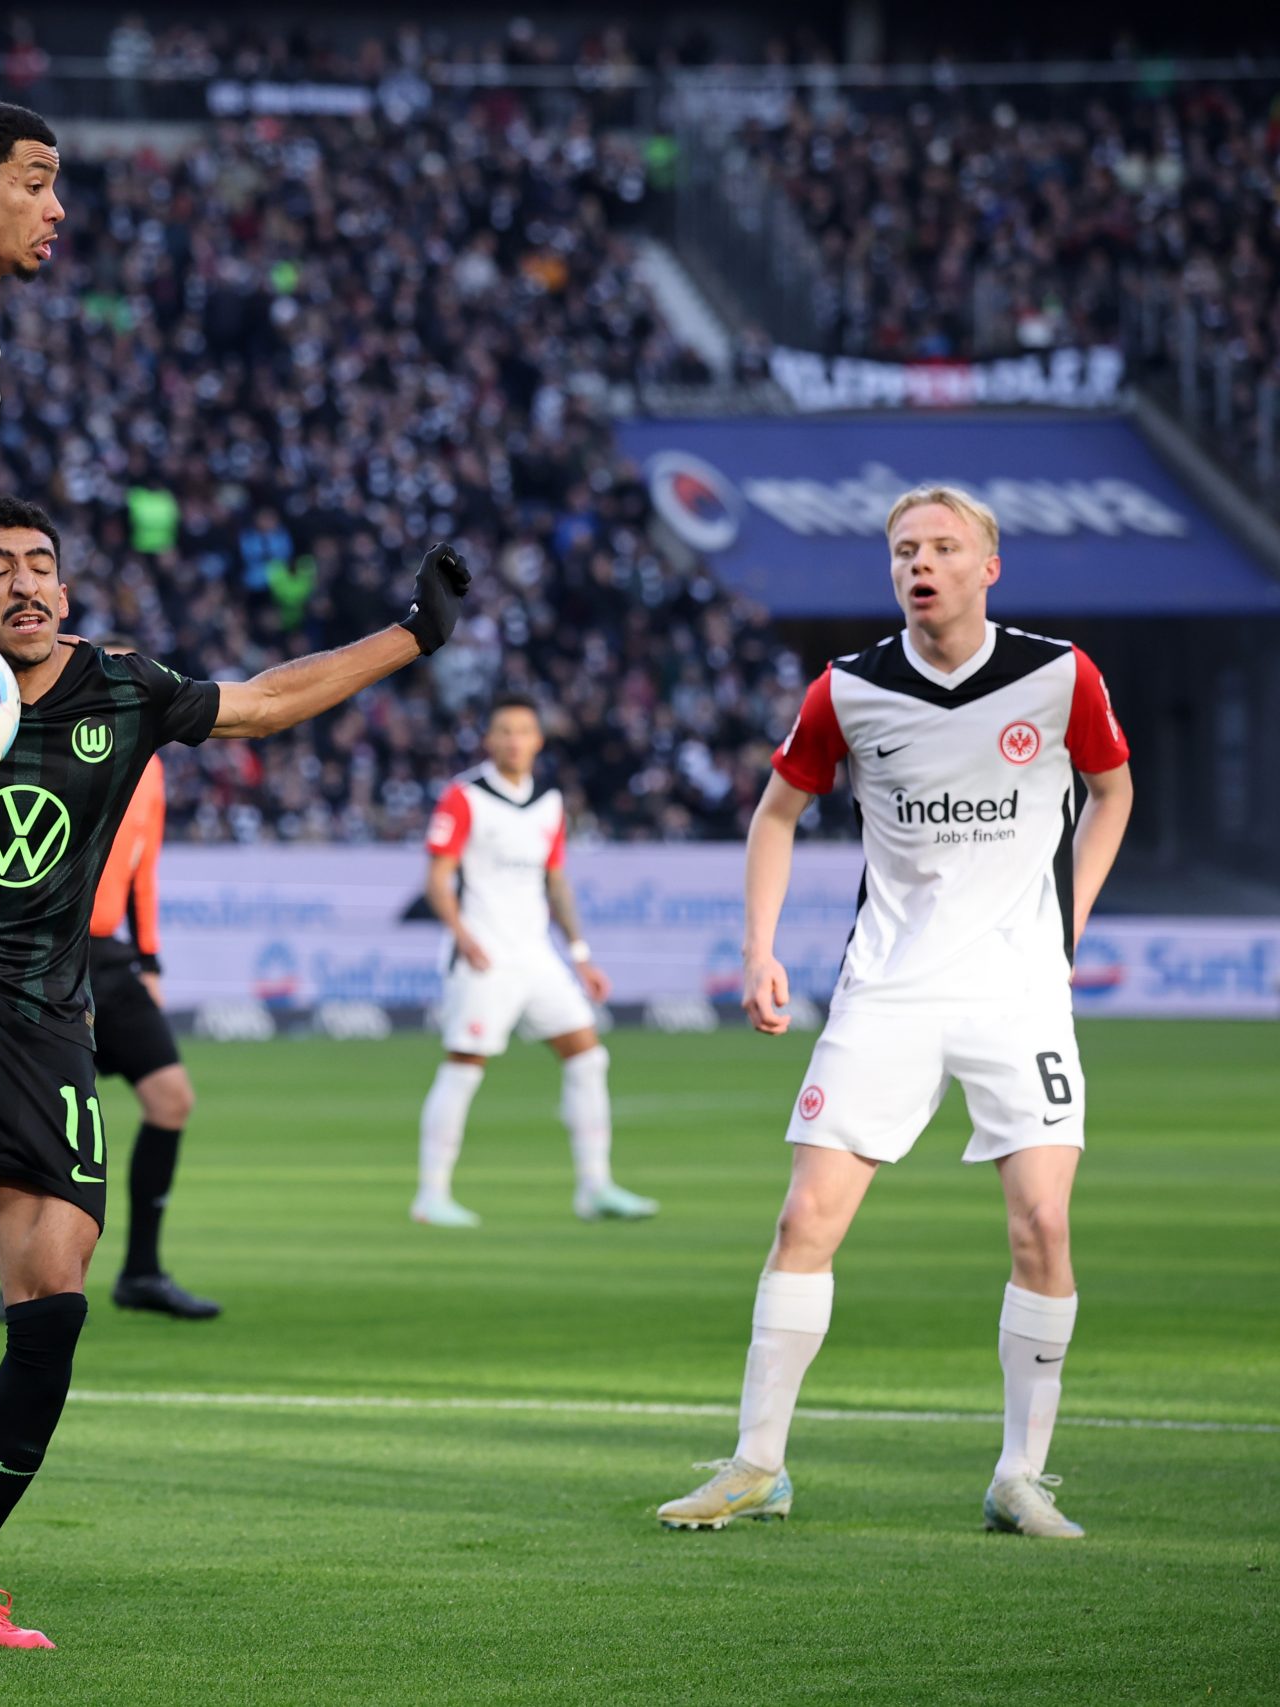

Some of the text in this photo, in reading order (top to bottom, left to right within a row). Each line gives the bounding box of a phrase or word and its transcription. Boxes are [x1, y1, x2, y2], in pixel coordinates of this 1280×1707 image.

[896, 789, 1019, 824] indeed
[933, 831, 969, 844] Jobs
[1035, 1051, 1073, 1105] 6
[59, 1085, 104, 1165] 11
